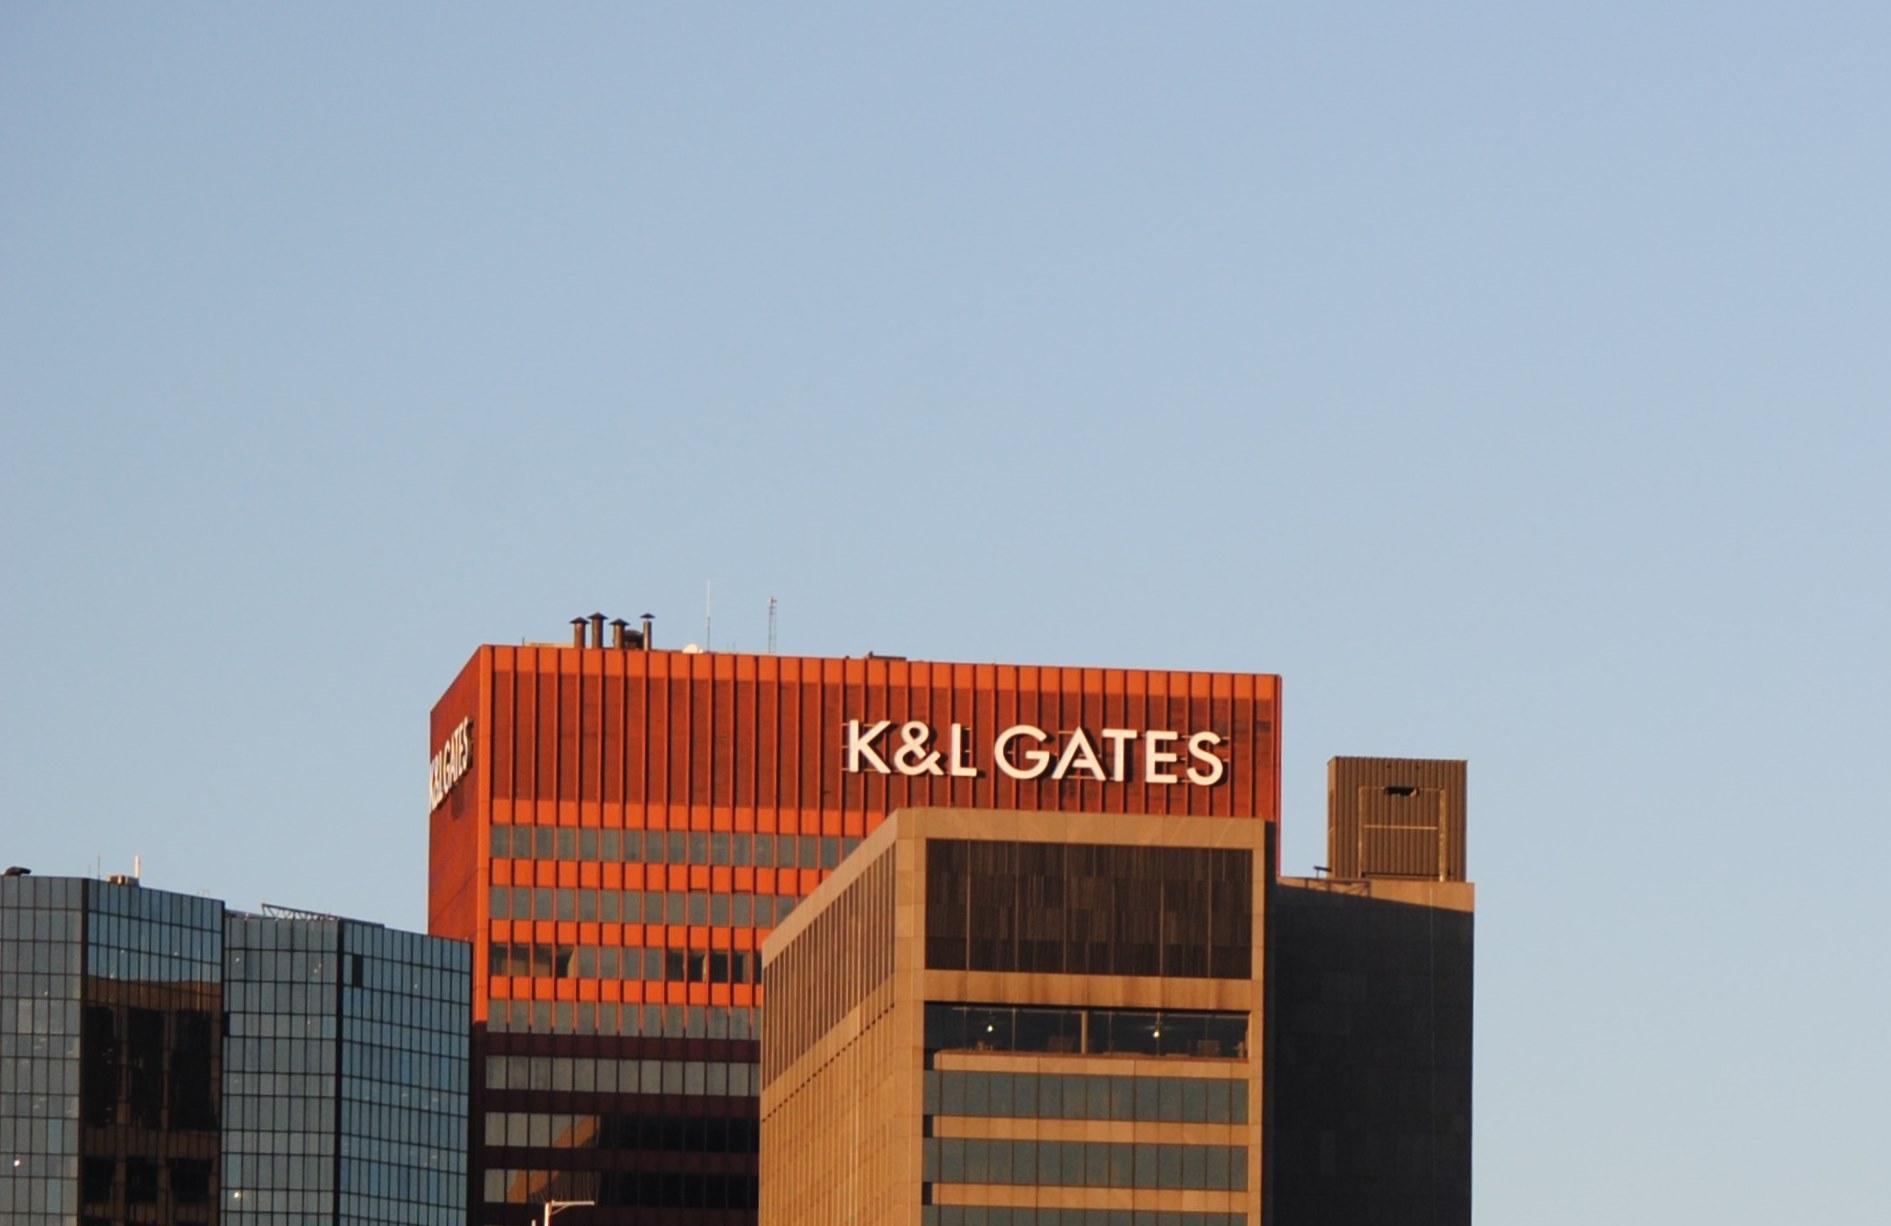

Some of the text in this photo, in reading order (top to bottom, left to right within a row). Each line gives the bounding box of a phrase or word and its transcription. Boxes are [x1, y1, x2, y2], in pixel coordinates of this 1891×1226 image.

[443, 715, 469, 795] GATES
[848, 719, 1224, 786] K&L GATES
